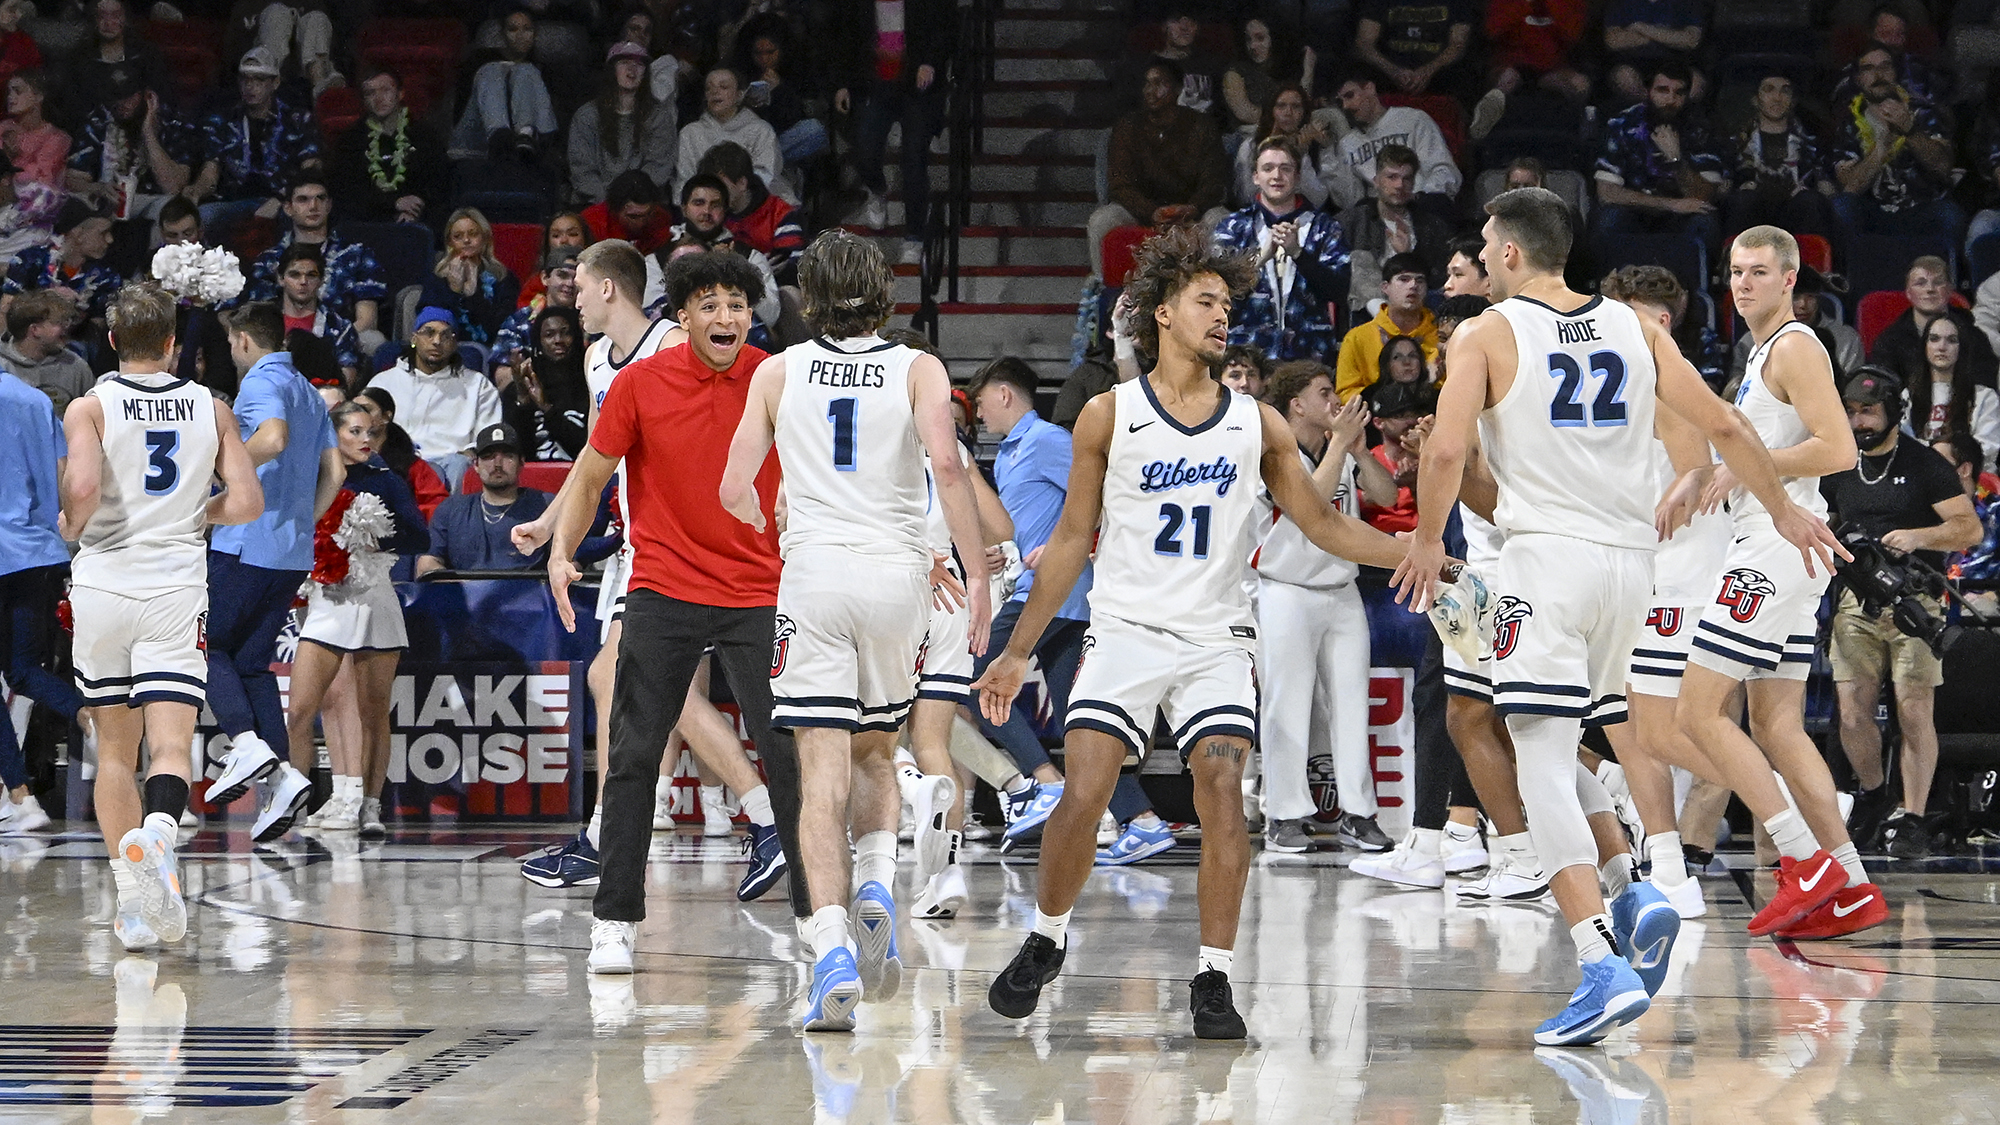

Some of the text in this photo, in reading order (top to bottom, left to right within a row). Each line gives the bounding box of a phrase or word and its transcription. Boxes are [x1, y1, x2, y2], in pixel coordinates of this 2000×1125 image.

[808, 359, 886, 389] PEEBLES
[1546, 349, 1628, 428] 22
[122, 398, 195, 422] METHENY
[826, 396, 860, 472] 1
[143, 429, 181, 497] 3
[1139, 455, 1239, 498] Liberty
[1154, 502, 1223, 560] 21
